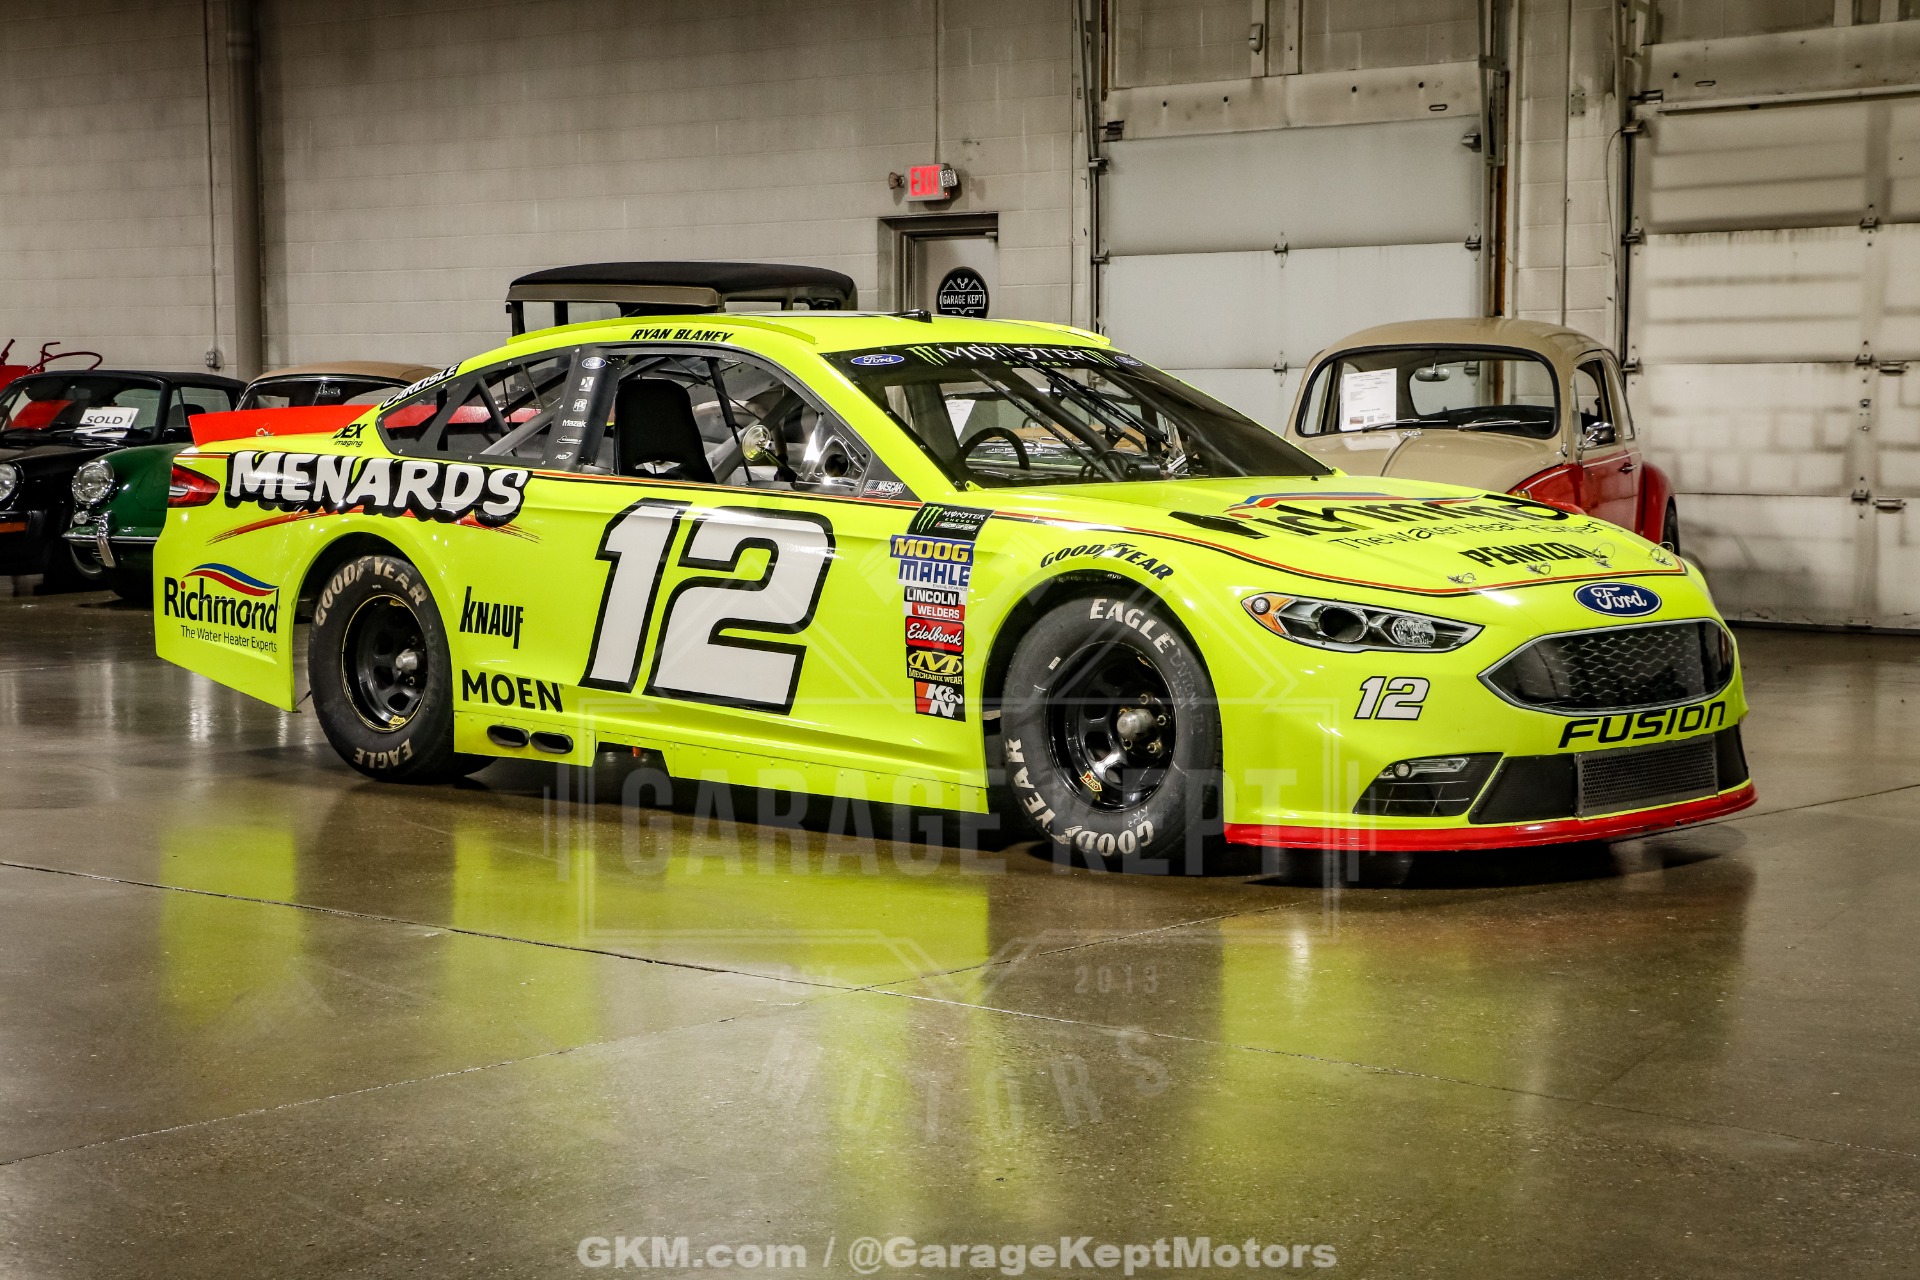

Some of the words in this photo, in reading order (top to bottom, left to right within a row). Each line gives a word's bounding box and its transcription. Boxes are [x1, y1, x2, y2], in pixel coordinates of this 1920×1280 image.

[910, 167, 941, 197] EXIT
[943, 295, 966, 305] GARAGE
[967, 294, 983, 305] KEPT
[630, 329, 672, 340] RYAN
[673, 330, 734, 342] BLANEY
[381, 362, 460, 409] CARLISLE
[85, 415, 123, 425] SOLD
[562, 419, 587, 428] Mazak
[333, 440, 363, 448] imaging
[226, 451, 532, 523] MENARDS
[1168, 494, 1569, 539] ichmnd
[893, 538, 971, 563] MOOG
[1040, 543, 1174, 580] GOODYEAR
[899, 559, 971, 587] MAHLE
[164, 576, 279, 634] Richmond
[315, 556, 428, 627] GOODYEAR
[577, 497, 836, 716] 12
[906, 587, 957, 606] LINCOLN
[1590, 587, 1648, 612] Ford
[459, 586, 524, 650] KNAUF
[917, 604, 960, 619] WELDERS
[1089, 598, 1177, 654] EAGLE
[181, 625, 196, 639] The
[197, 628, 222, 642] Water
[223, 632, 250, 648] Heater
[251, 636, 277, 653] Experts
[907, 622, 962, 646] Edelbrock
[461, 668, 564, 713] MOEN
[908, 667, 943, 682] MECHANIX
[943, 675, 963, 685] WEAR
[1354, 675, 1431, 721] 12
[1557, 700, 1726, 749] FUSION
[353, 738, 414, 769] EAGLE
[1004, 738, 1155, 857] GOODYEAR
